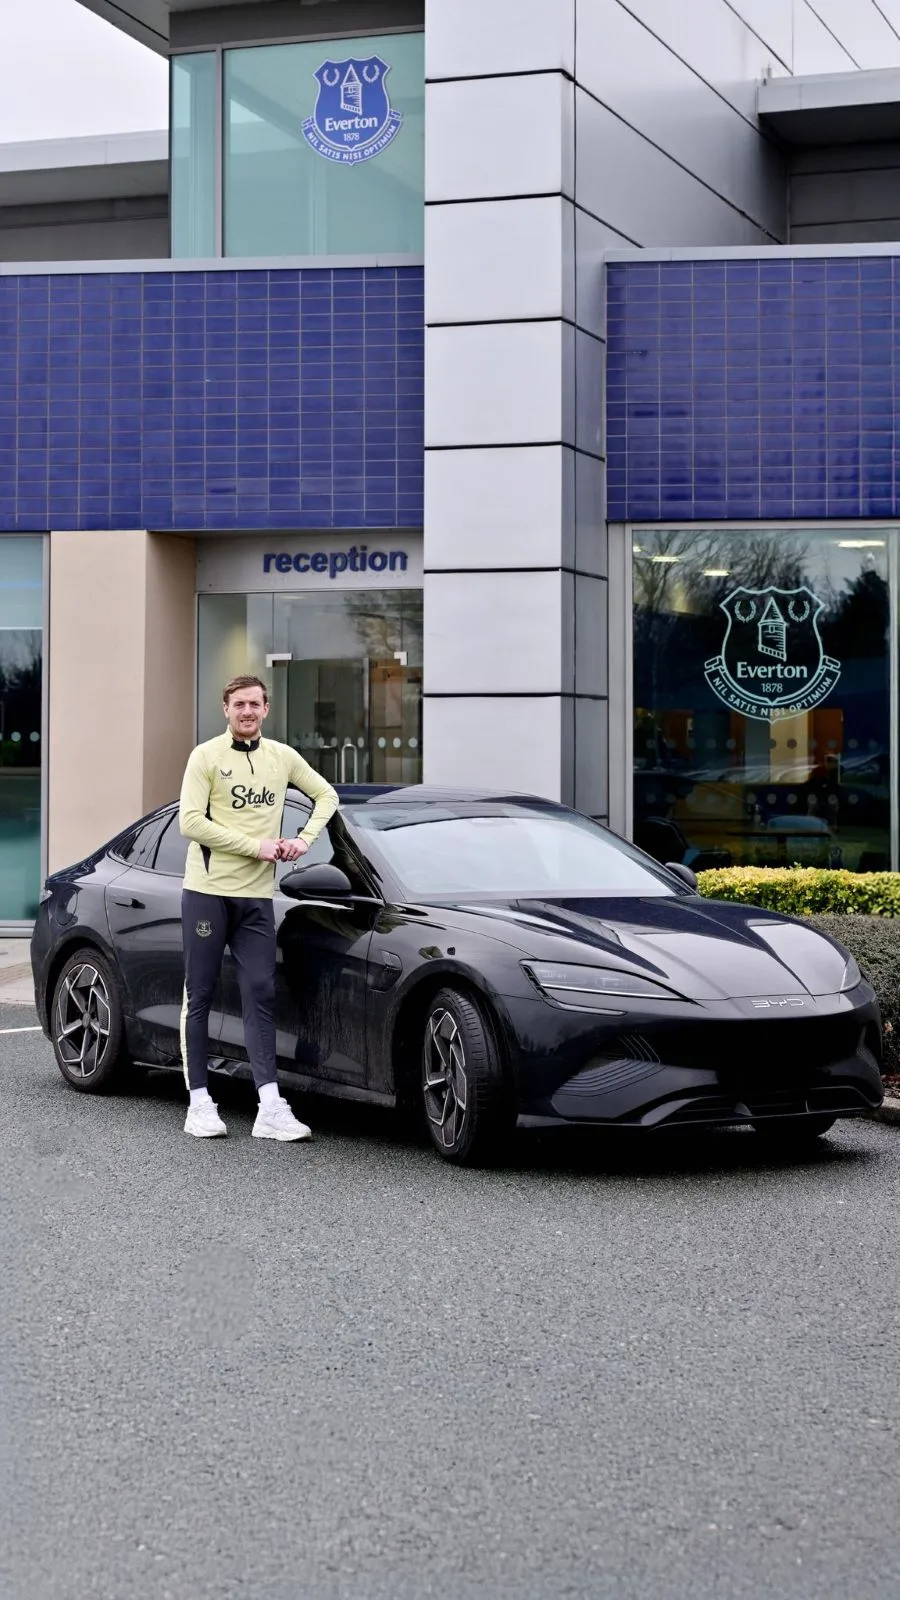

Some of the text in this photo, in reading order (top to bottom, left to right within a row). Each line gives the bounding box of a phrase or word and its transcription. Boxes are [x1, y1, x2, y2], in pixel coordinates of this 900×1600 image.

[325, 117, 378, 131] Everton
[307, 125, 396, 160] NIL SATIS NISI OPTIMUM
[344, 133, 360, 142] 1878
[263, 545, 408, 579] reception
[737, 662, 808, 678] Everton
[761, 683, 783, 693] 1878
[712, 677, 832, 716] NIL SATIS NISI OPTIMUM
[231, 785, 275, 809] Stake
[751, 998, 804, 1008] BYD
